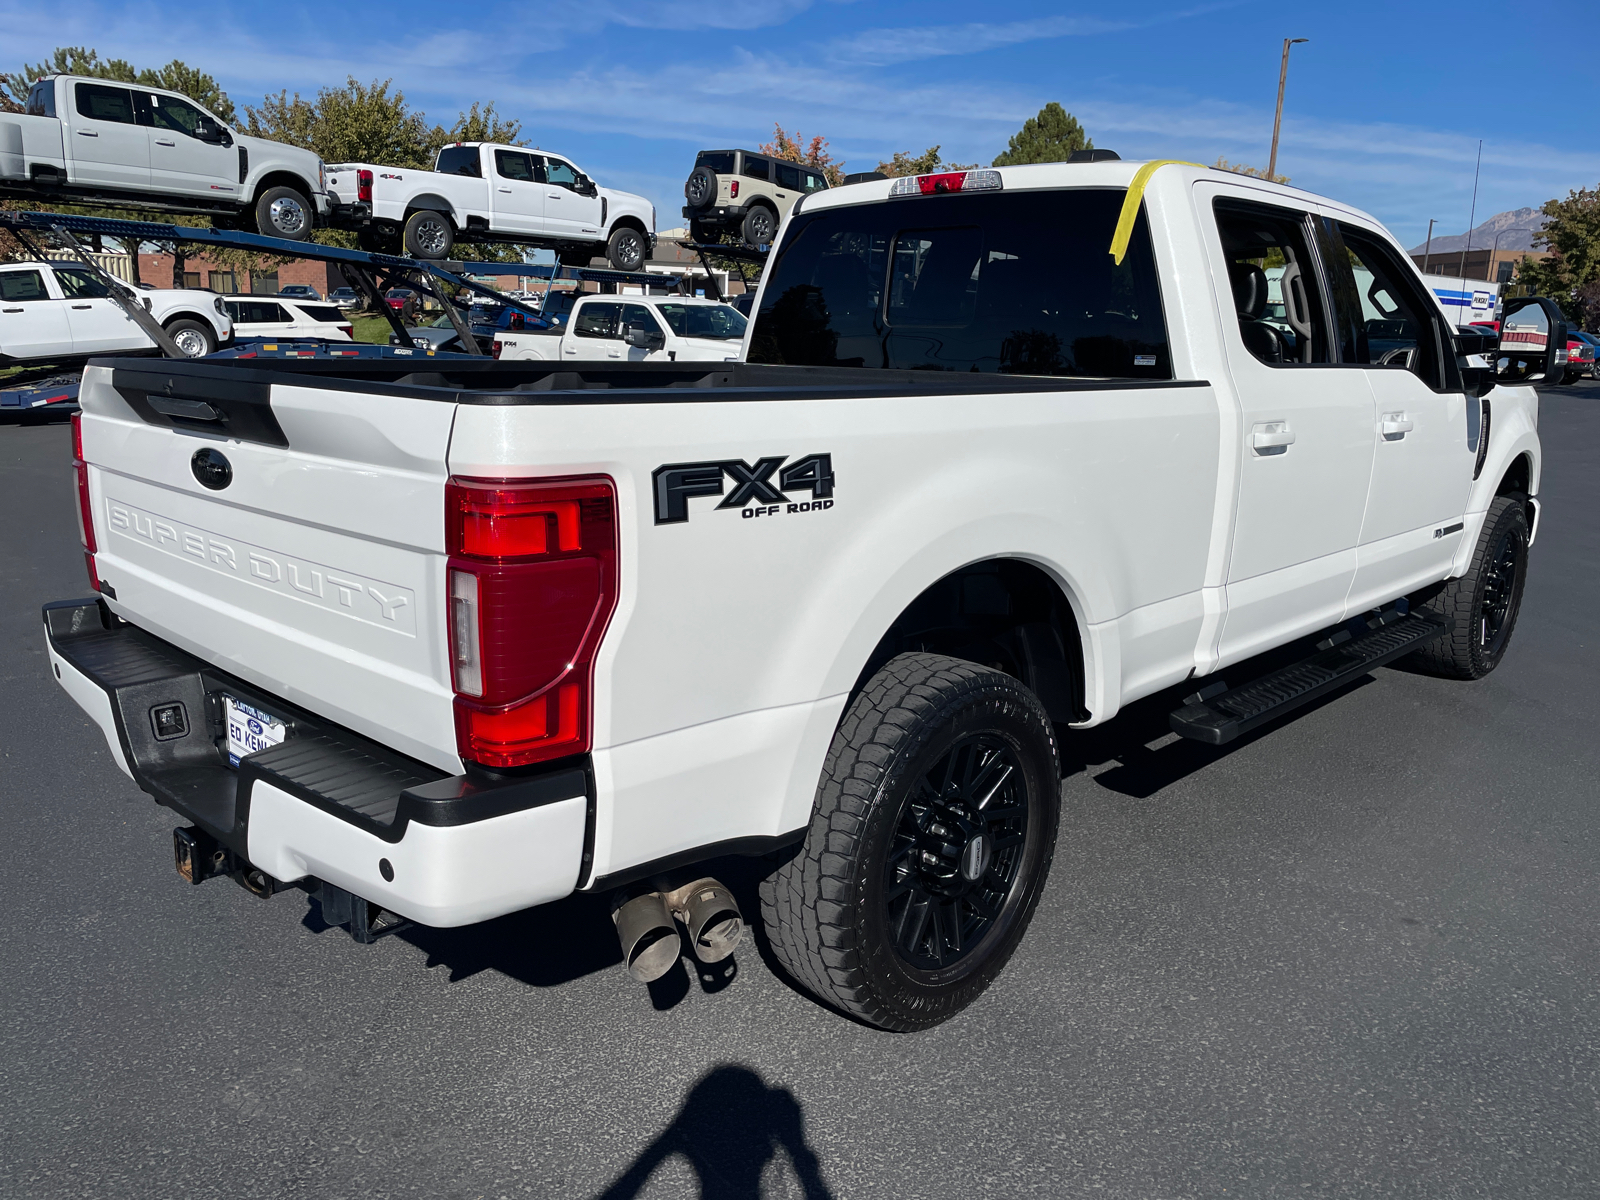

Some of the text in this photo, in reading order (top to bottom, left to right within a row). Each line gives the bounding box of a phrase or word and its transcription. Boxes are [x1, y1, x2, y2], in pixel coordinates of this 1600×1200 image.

[651, 452, 835, 526] FX4
[741, 500, 834, 519] OFF ROAD
[110, 506, 408, 622] SUPER DUTY
[230, 723, 242, 742] ED
